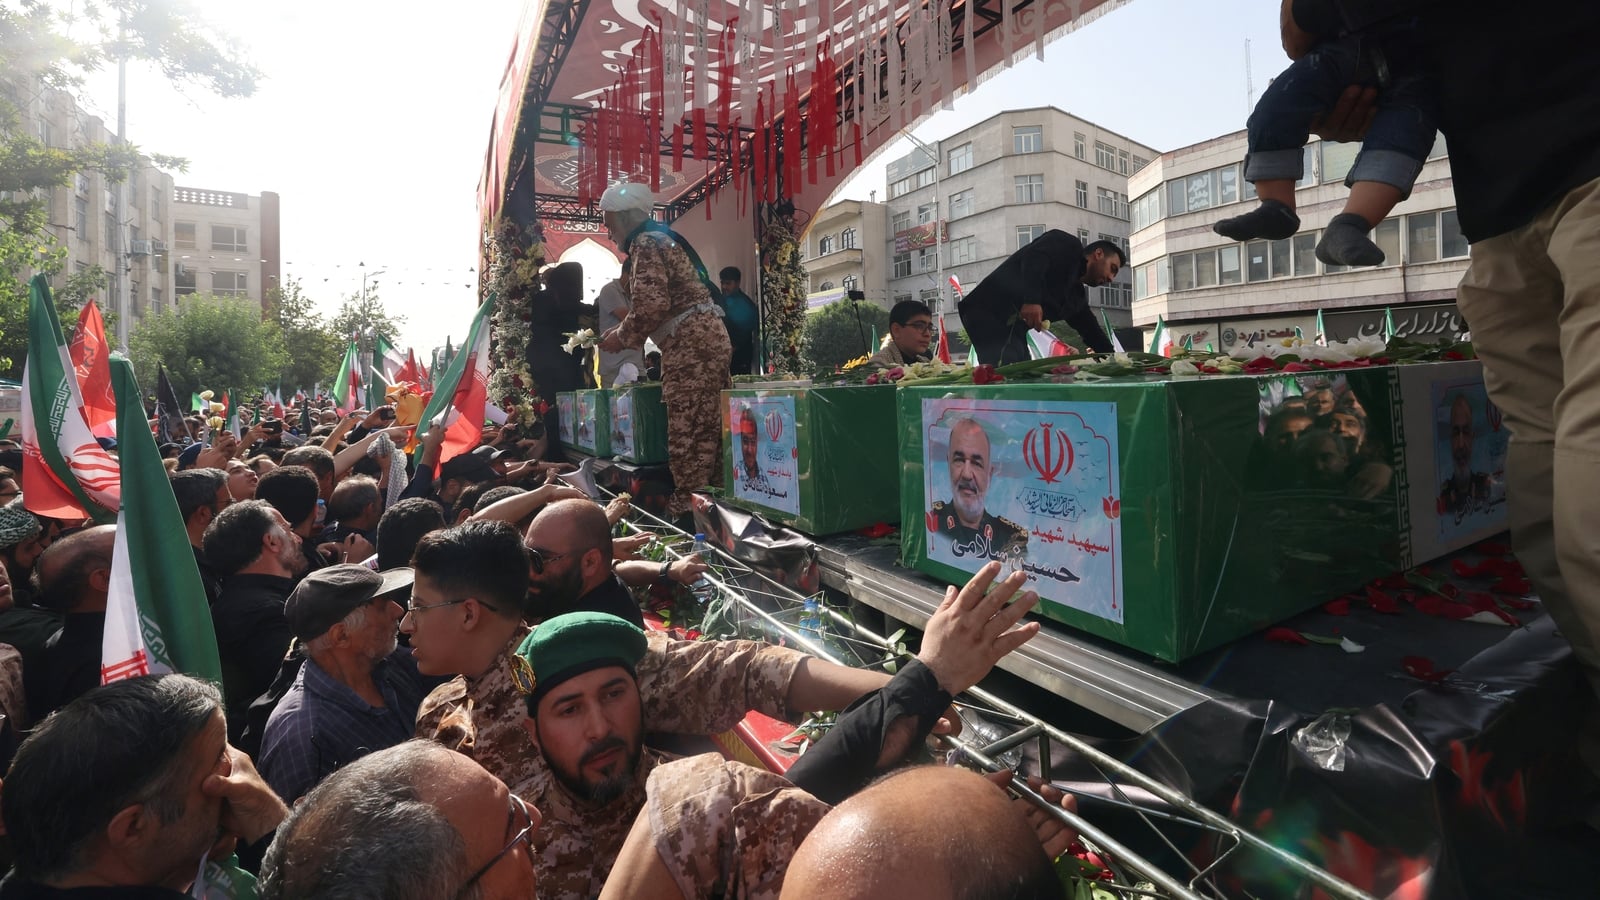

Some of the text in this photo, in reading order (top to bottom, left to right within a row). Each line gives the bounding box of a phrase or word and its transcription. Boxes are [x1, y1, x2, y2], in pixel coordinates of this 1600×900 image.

[951, 532, 1081, 583] حسین سلامی
[1031, 525, 1110, 557] سپهبد شهید
